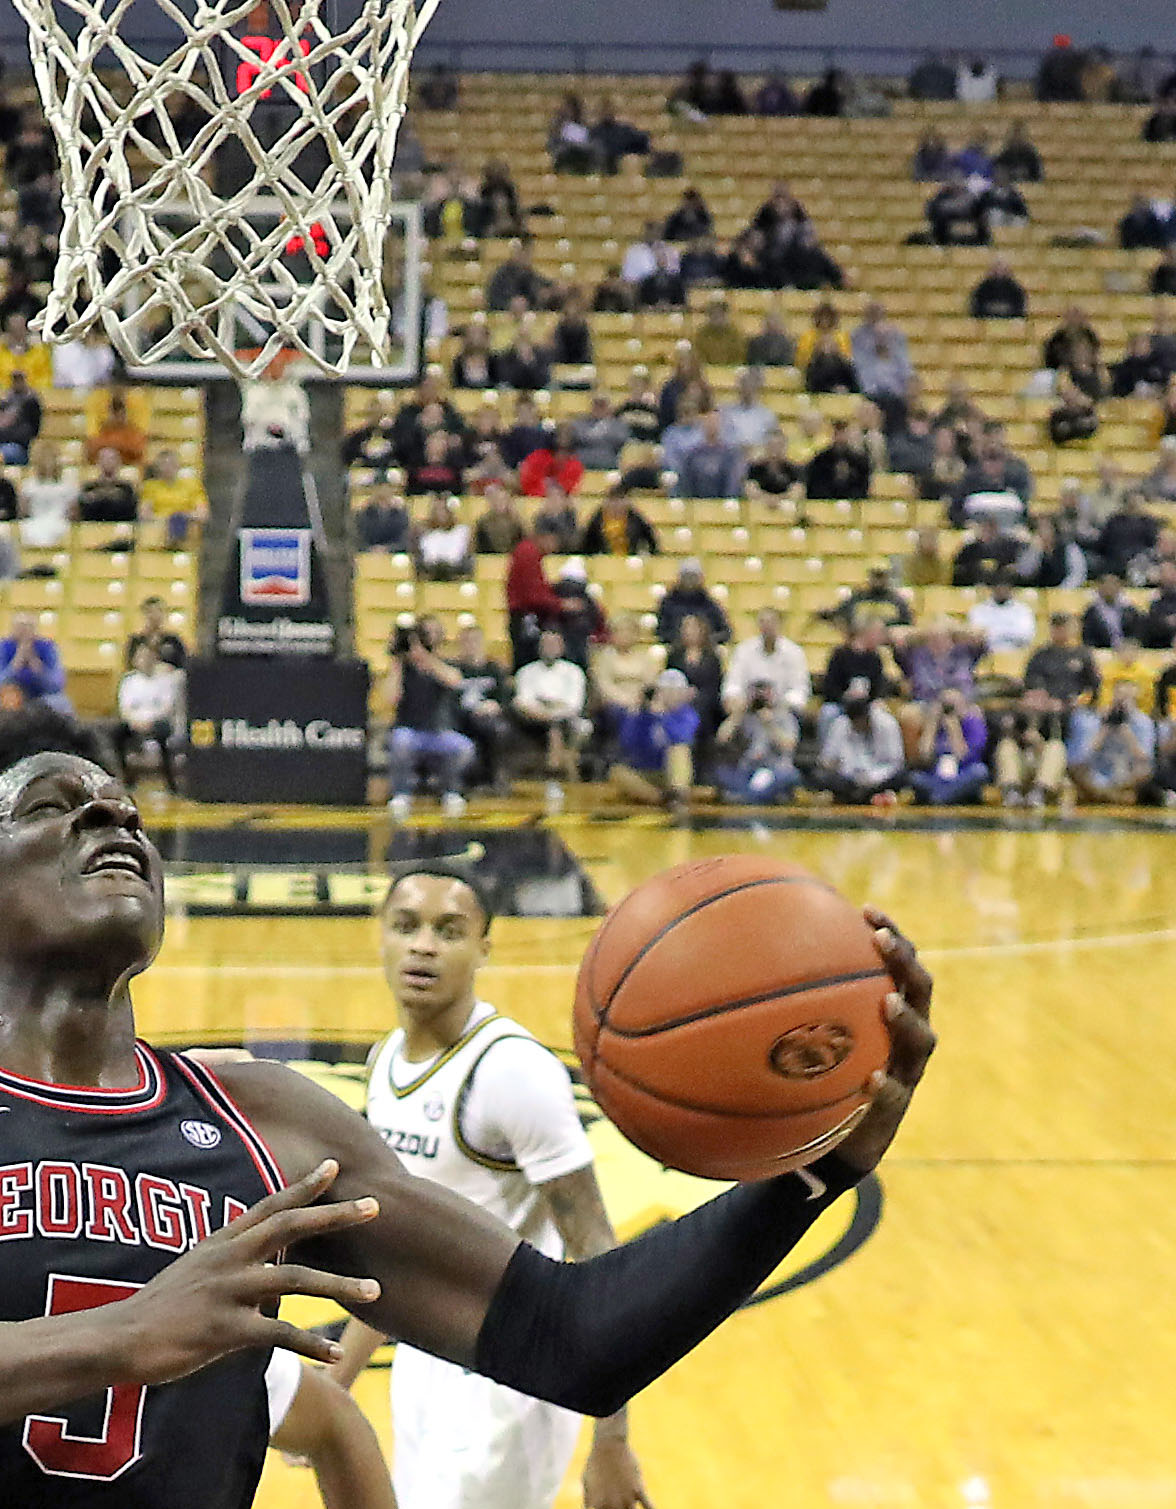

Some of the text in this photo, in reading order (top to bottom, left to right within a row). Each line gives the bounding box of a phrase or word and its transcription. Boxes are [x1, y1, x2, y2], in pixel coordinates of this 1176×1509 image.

[221, 719, 365, 748] Health Care
[182, 1120, 220, 1147] SEC
